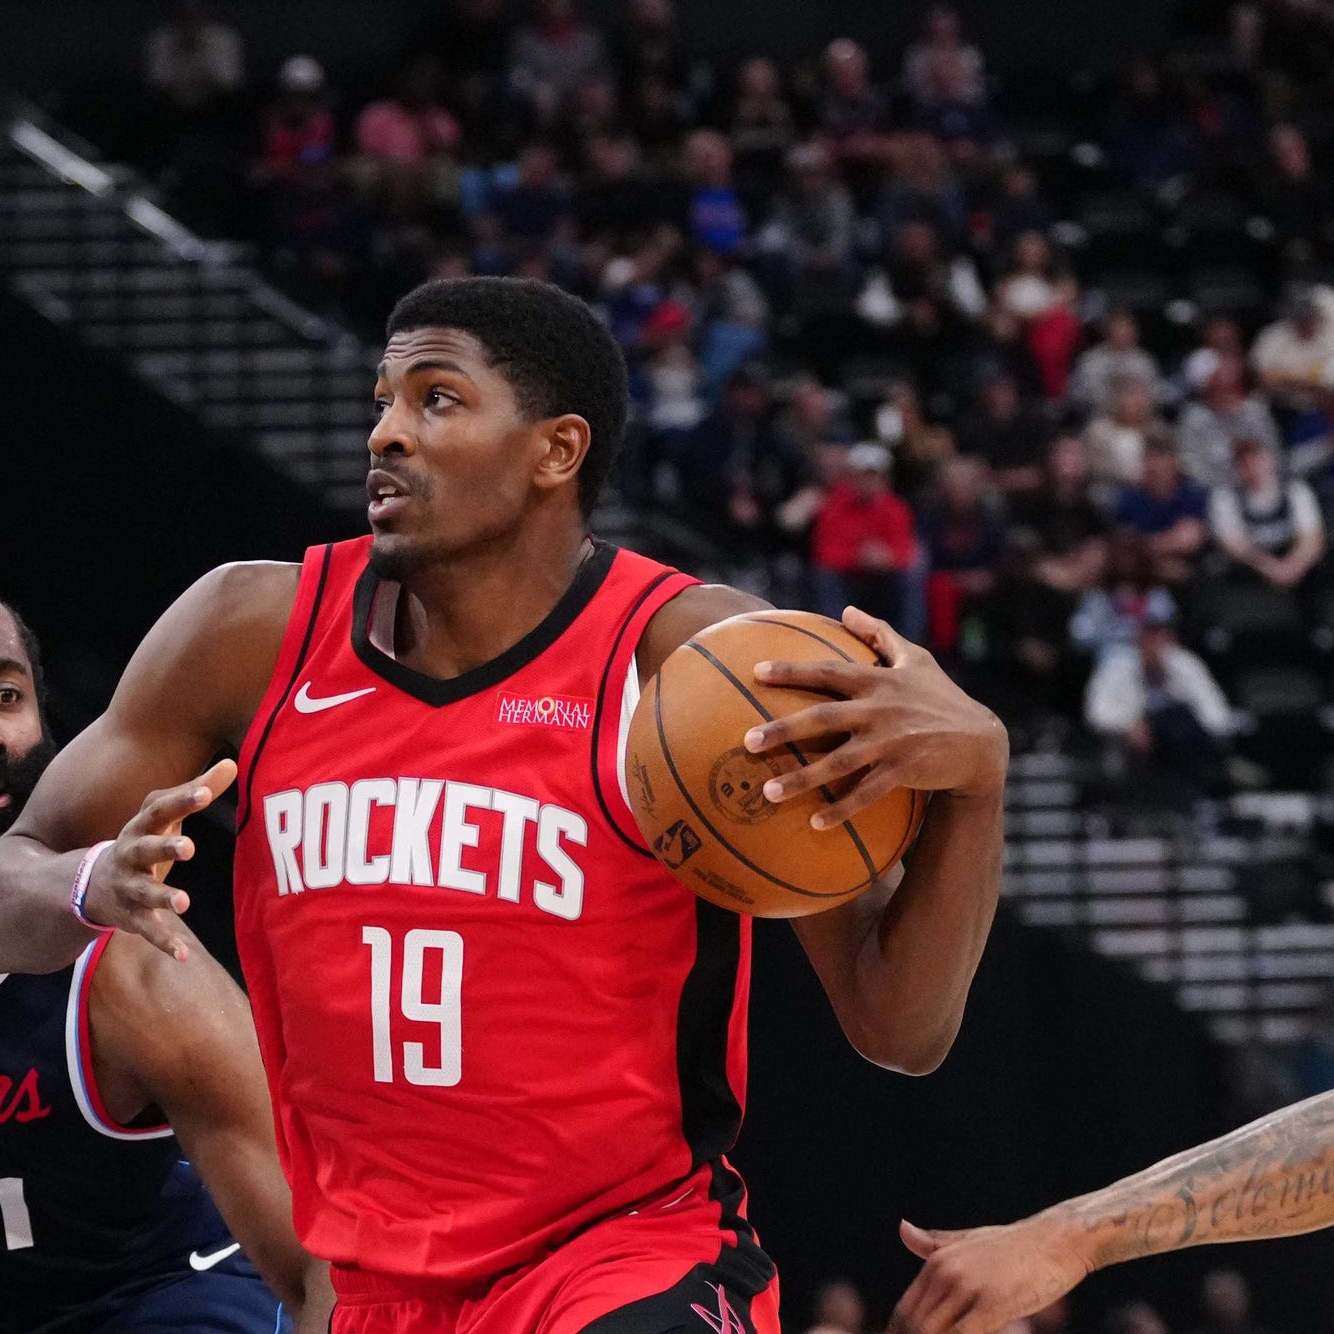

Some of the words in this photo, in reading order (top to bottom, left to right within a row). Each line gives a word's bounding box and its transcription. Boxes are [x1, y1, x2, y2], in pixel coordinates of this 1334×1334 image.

[498, 708, 589, 728] HERMANN
[500, 697, 590, 717] MEMORIAL
[264, 777, 588, 921] ROCKETS
[360, 926, 464, 1086] 19
